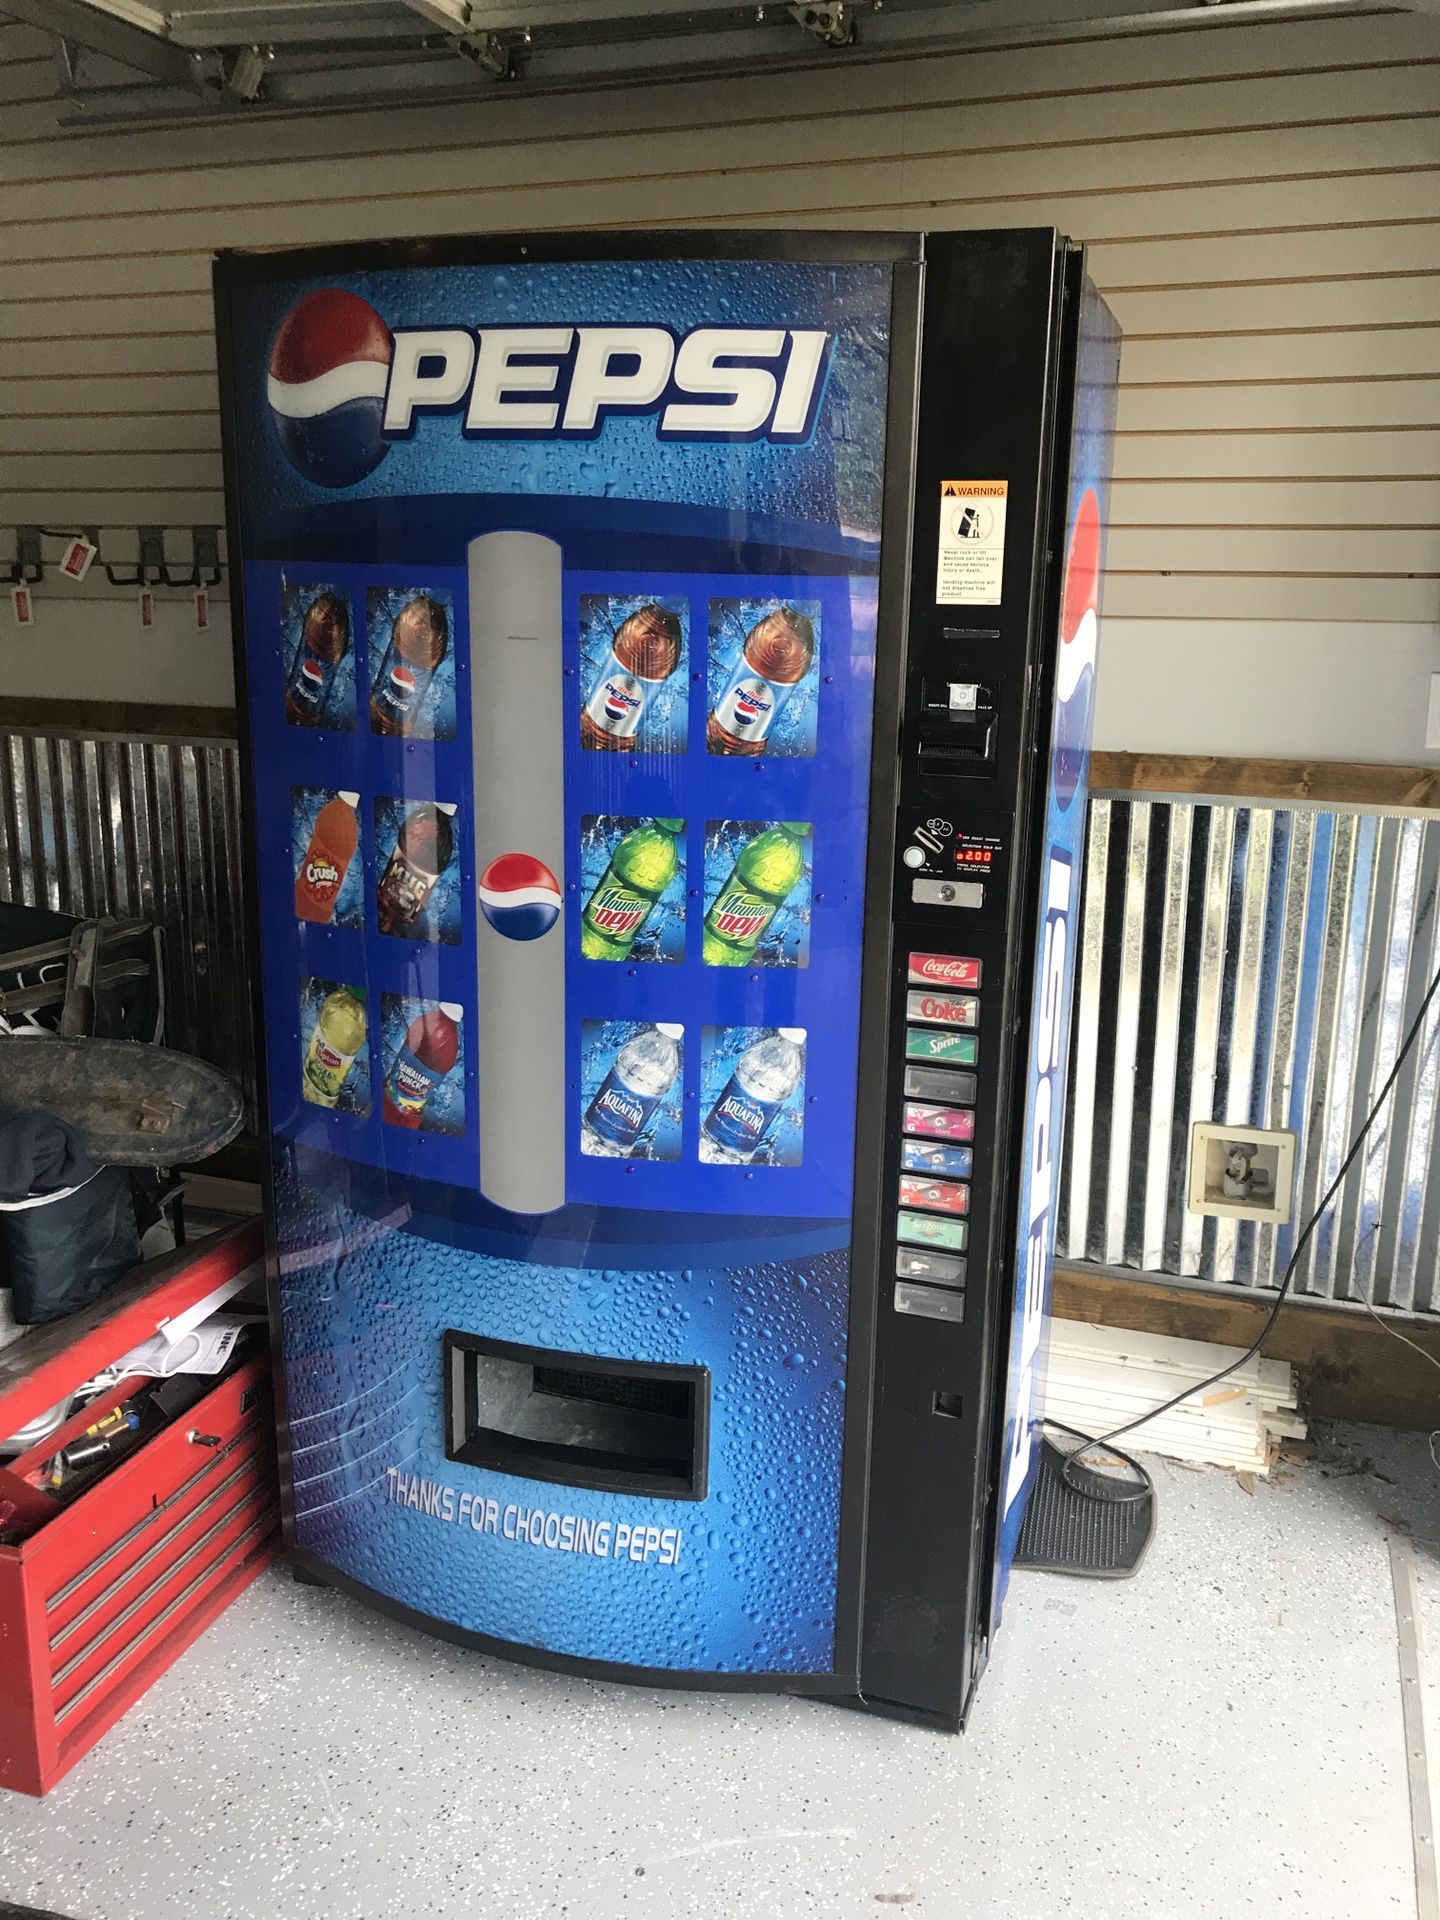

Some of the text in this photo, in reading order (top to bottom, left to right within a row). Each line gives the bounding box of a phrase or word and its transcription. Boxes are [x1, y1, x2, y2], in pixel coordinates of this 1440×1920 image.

[383, 326, 830, 434] PEPSI
[958, 487, 1004, 496] WARNING
[605, 682, 641, 707] PEPSI
[617, 685, 634, 697] diet
[734, 687, 771, 712] PEPSI
[746, 689, 765, 701] diet
[306, 863, 339, 883] Crush
[389, 862, 427, 900] MUG
[923, 959, 971, 978] Coca-Cola
[921, 996, 967, 1021] Coke
[929, 1035, 961, 1054] Sprite
[598, 1088, 643, 1128] AQUAFINA
[719, 1094, 765, 1134] AQUAFINA
[907, 1123, 916, 1131] G
[905, 1159, 914, 1168] G
[901, 1195, 910, 1203] G
[1002, 860, 1072, 1523] PEPSI
[386, 1466, 683, 1565] THANKS FOR CHOOSING PEPSI
